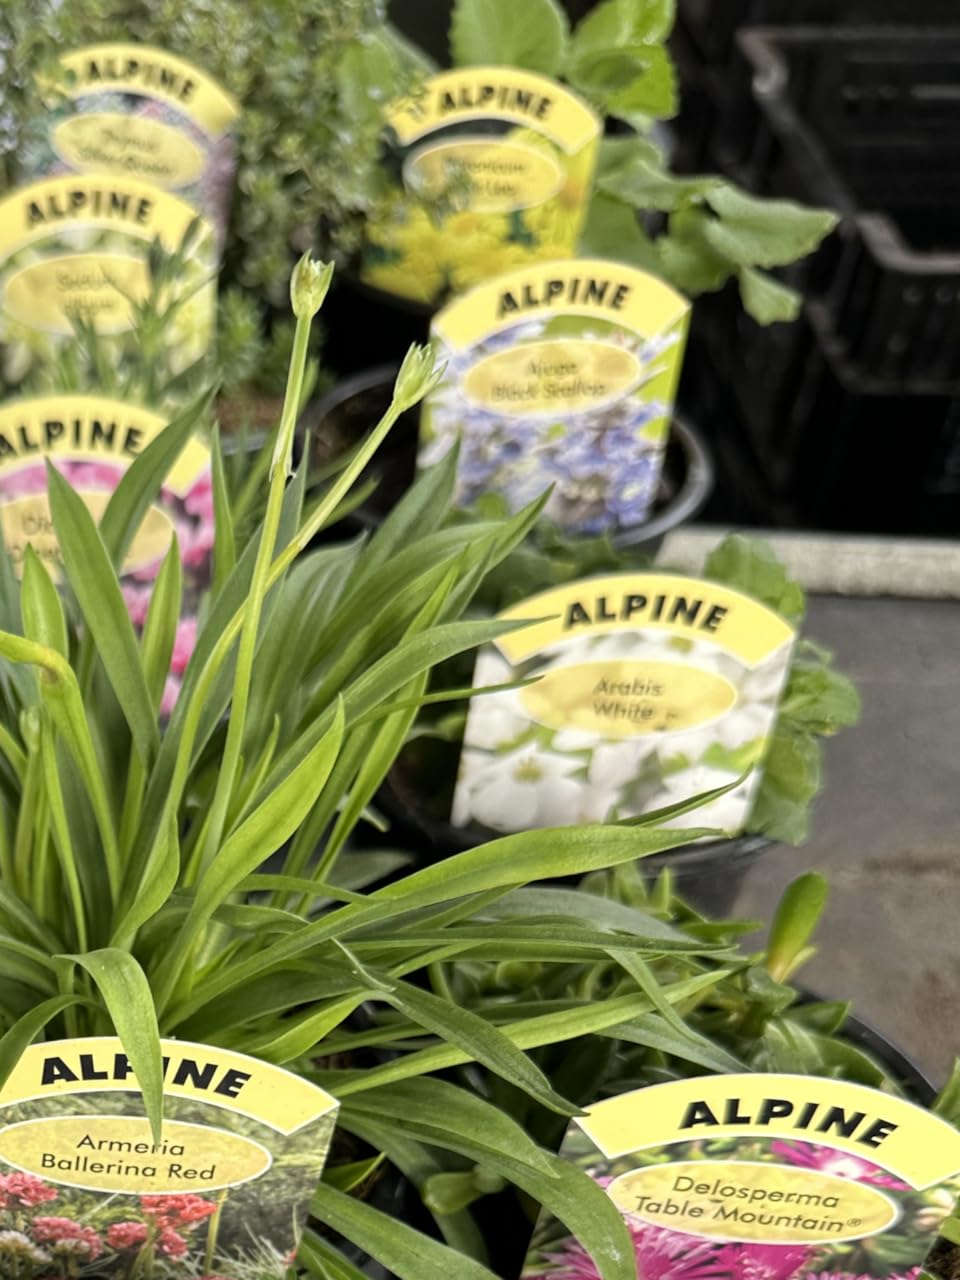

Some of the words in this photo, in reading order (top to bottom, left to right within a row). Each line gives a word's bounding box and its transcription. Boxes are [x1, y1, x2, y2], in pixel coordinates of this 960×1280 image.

[88, 58, 196, 100] ALPINE
[438, 85, 555, 117] ALPINE
[26, 190, 155, 225] ALPINE
[497, 276, 633, 318] ALPINE
[561, 593, 730, 633] ALPINE
[593, 676, 664, 698] Arabis
[593, 699, 655, 721] White
[678, 1098, 899, 1149] ALPINE
[76, 1133, 186, 1157] Armeria
[41, 1153, 157, 1178] Ballerina
[168, 1163, 217, 1181] Red
[635, 1195, 705, 1219] Table
[672, 1175, 841, 1209] Delosperma
